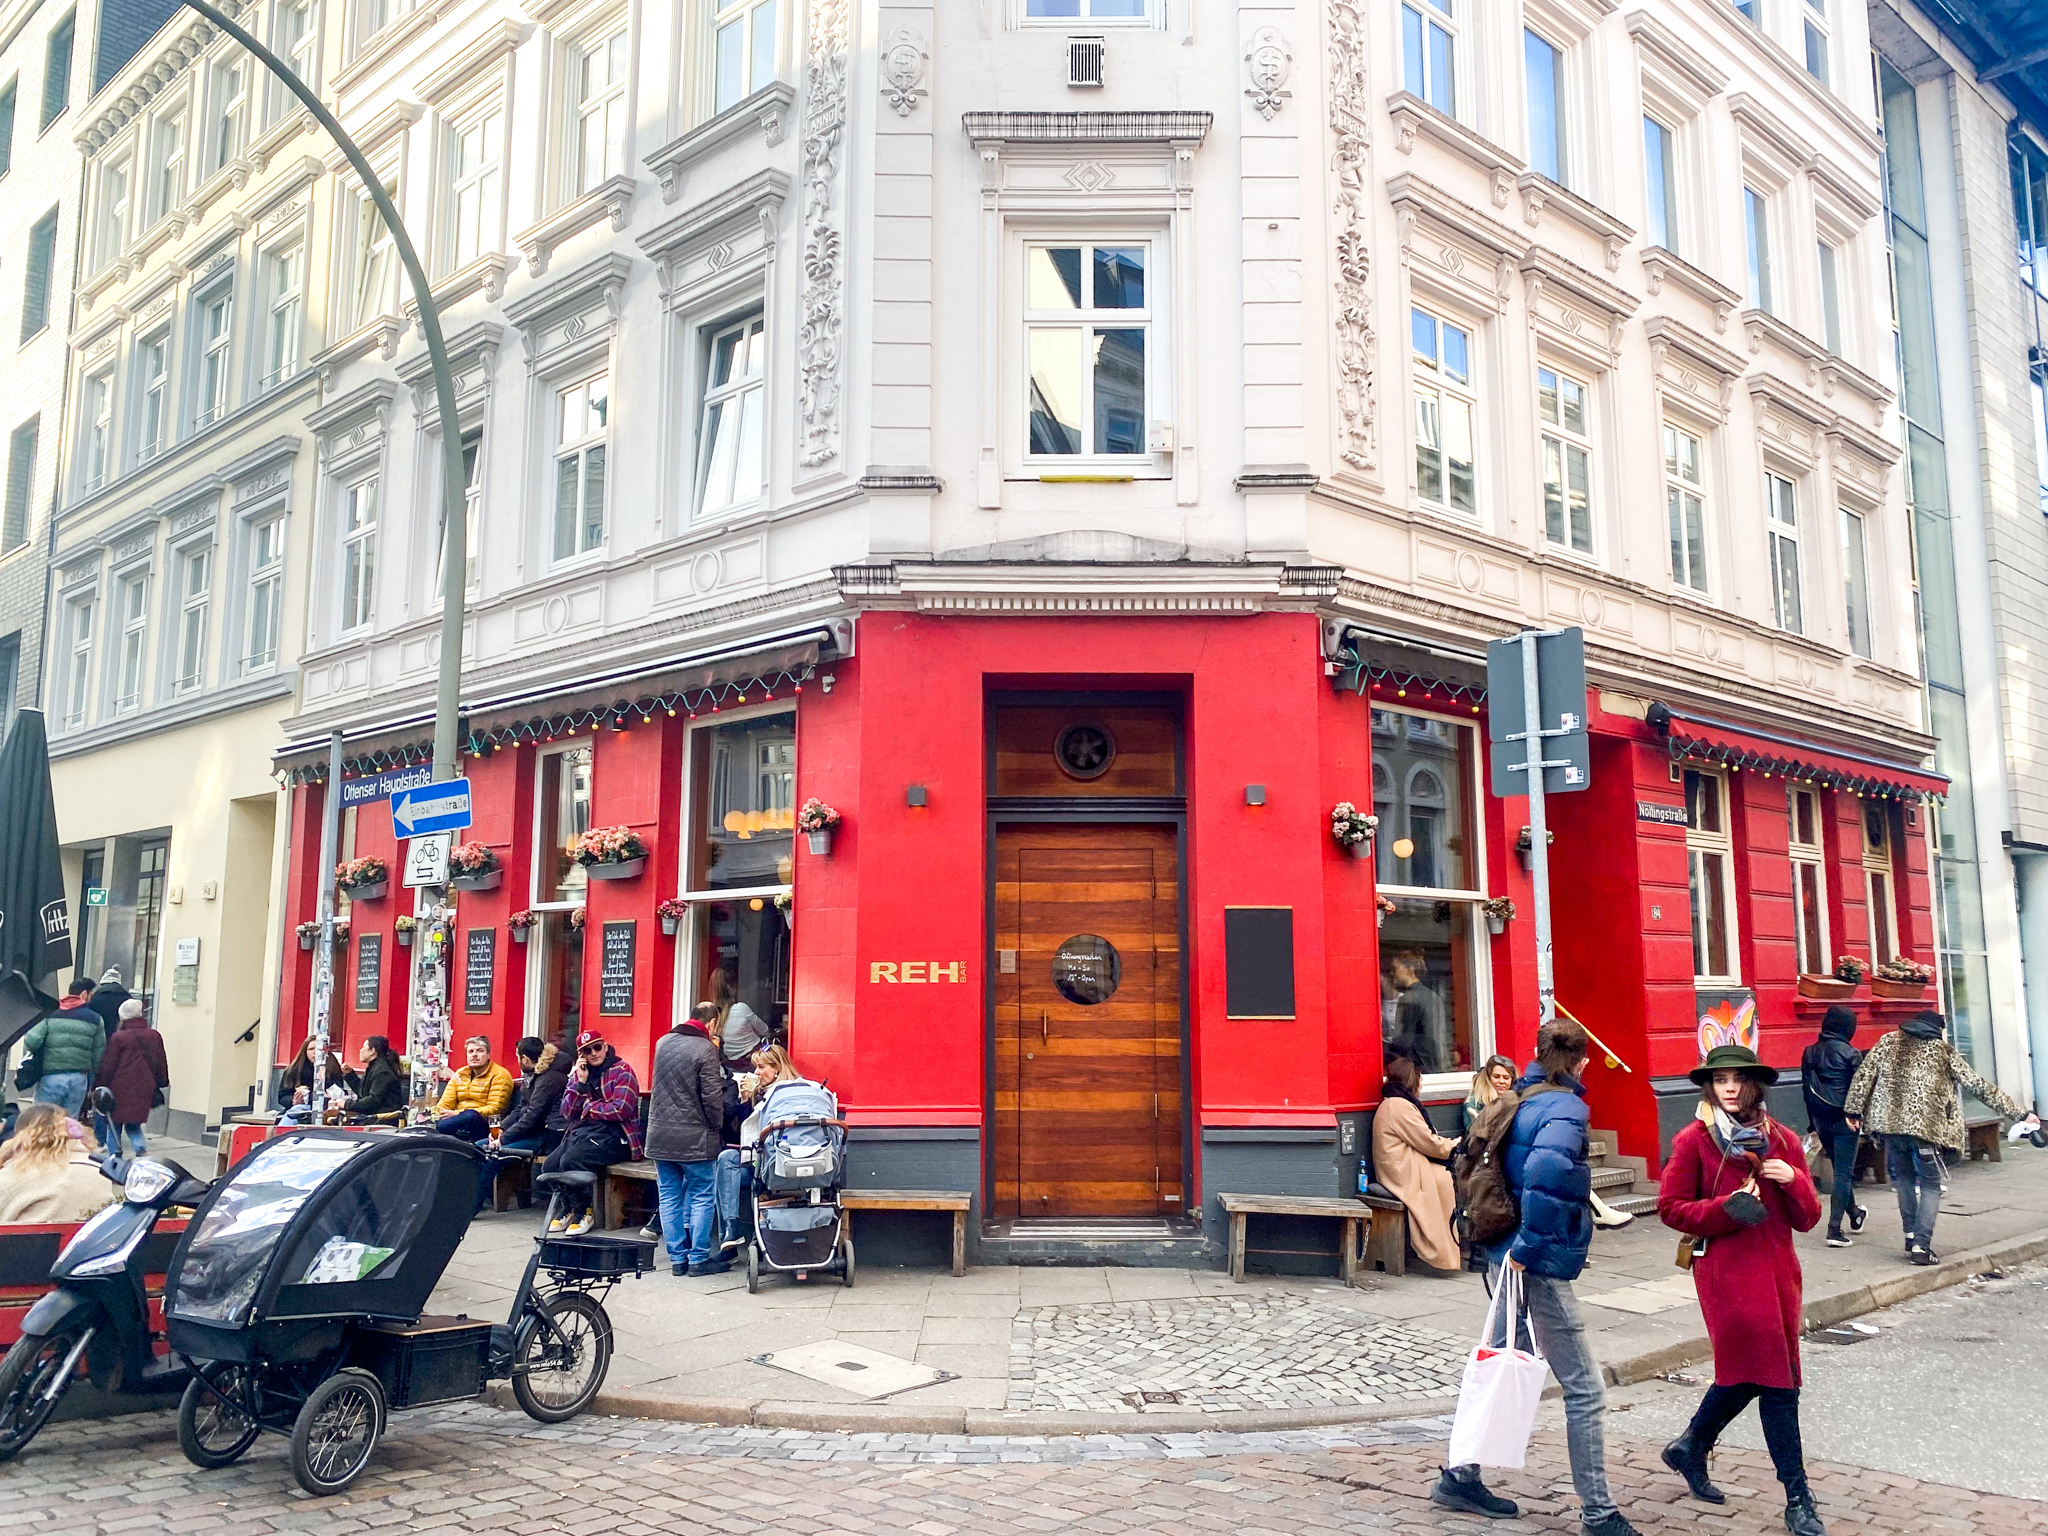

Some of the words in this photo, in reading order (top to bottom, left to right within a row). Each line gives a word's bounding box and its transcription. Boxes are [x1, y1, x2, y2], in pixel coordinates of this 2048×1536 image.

[810, 110, 834, 132] ANNO
[343, 781, 377, 802] Ottenser
[379, 768, 431, 795] Hauptstraße
[410, 798, 468, 817] Einbahstraße
[1638, 802, 1688, 822] Nöltingstraße
[870, 961, 959, 984] REH
[1082, 964, 1091, 972] So
